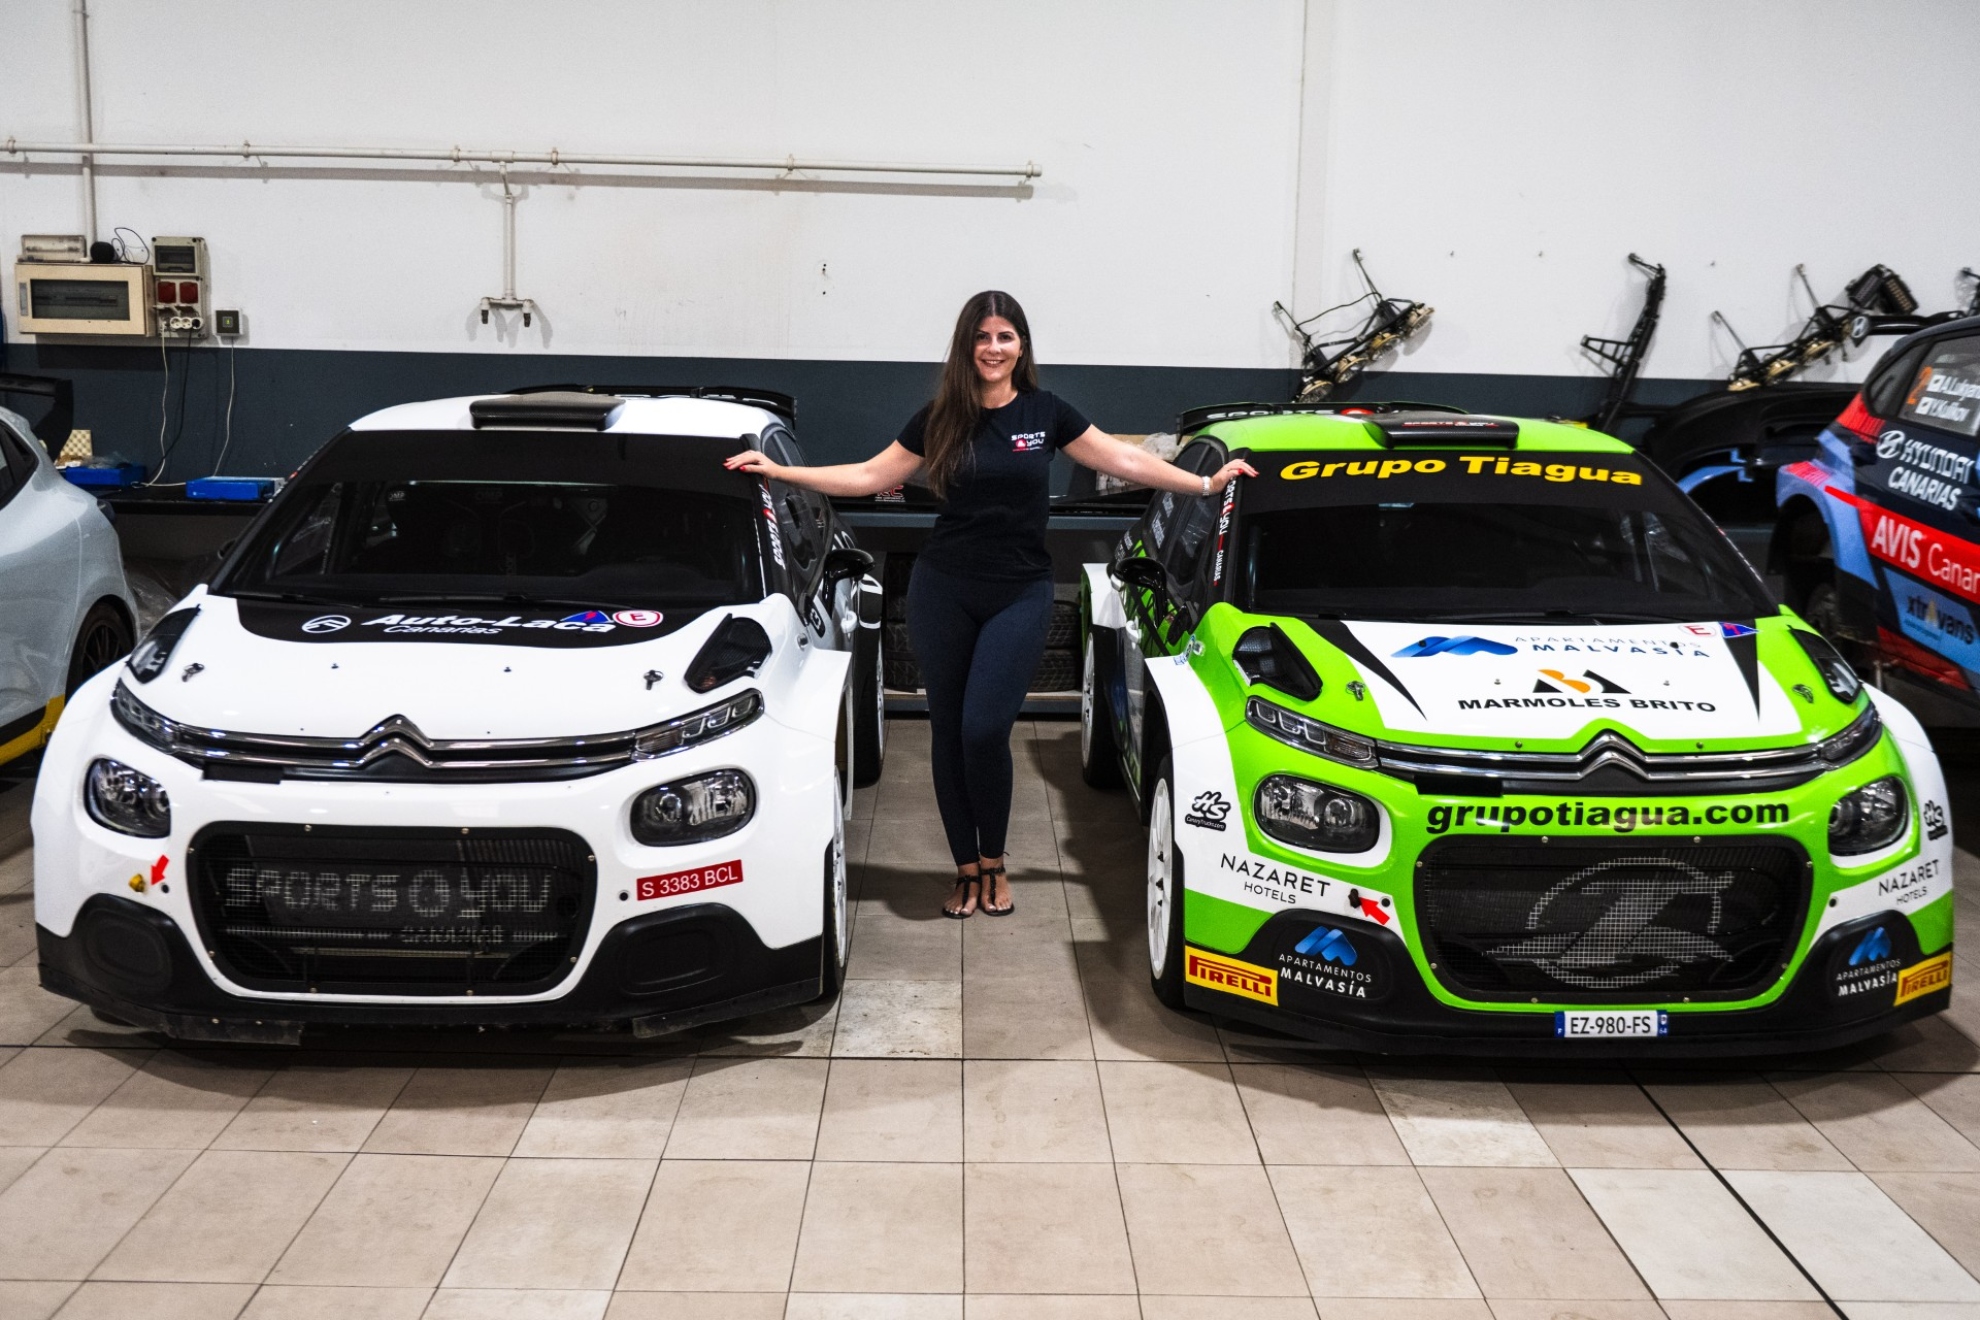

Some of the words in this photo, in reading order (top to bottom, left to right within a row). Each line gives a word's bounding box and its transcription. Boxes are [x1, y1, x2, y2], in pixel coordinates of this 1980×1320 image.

[1011, 431, 1046, 441] SPORTS
[1026, 438, 1044, 447] YOU
[1280, 456, 1446, 480] Grupo
[1459, 456, 1642, 485] Tiagua
[1899, 439, 1975, 484] HYUNDAI
[1224, 477, 1236, 506] ORTS
[1888, 467, 1962, 510] CANARIAS
[1219, 512, 1231, 535] YOU
[1871, 515, 1922, 568] AVIS
[361, 614, 616, 632] Auto-Laca
[384, 624, 504, 635] Canarias
[630, 612, 646, 622] E
[1683, 625, 1711, 635] E
[1458, 698, 1621, 709] MARMOLES
[1629, 699, 1716, 713] BRITO
[1426, 802, 1789, 834] grupotiagua.com
[226, 868, 400, 911] SPORTS
[642, 882, 654, 897] S
[660, 873, 700, 894] 3383
[704, 865, 738, 886] BCL
[1221, 853, 1330, 897] NAZARET
[1878, 859, 1940, 896] NAZARET
[1244, 882, 1296, 904] HOTELS
[1896, 886, 1928, 905] HOTELS
[1189, 955, 1272, 997] PIRELLI
[1278, 953, 1372, 983] APARTAMENTOS
[1280, 967, 1366, 998] MALVASÍA
[1836, 958, 1901, 981] APARTAMENTOS
[1900, 959, 1949, 998] PIRELLI
[1570, 1016, 1651, 1034] EZ-980-FS
